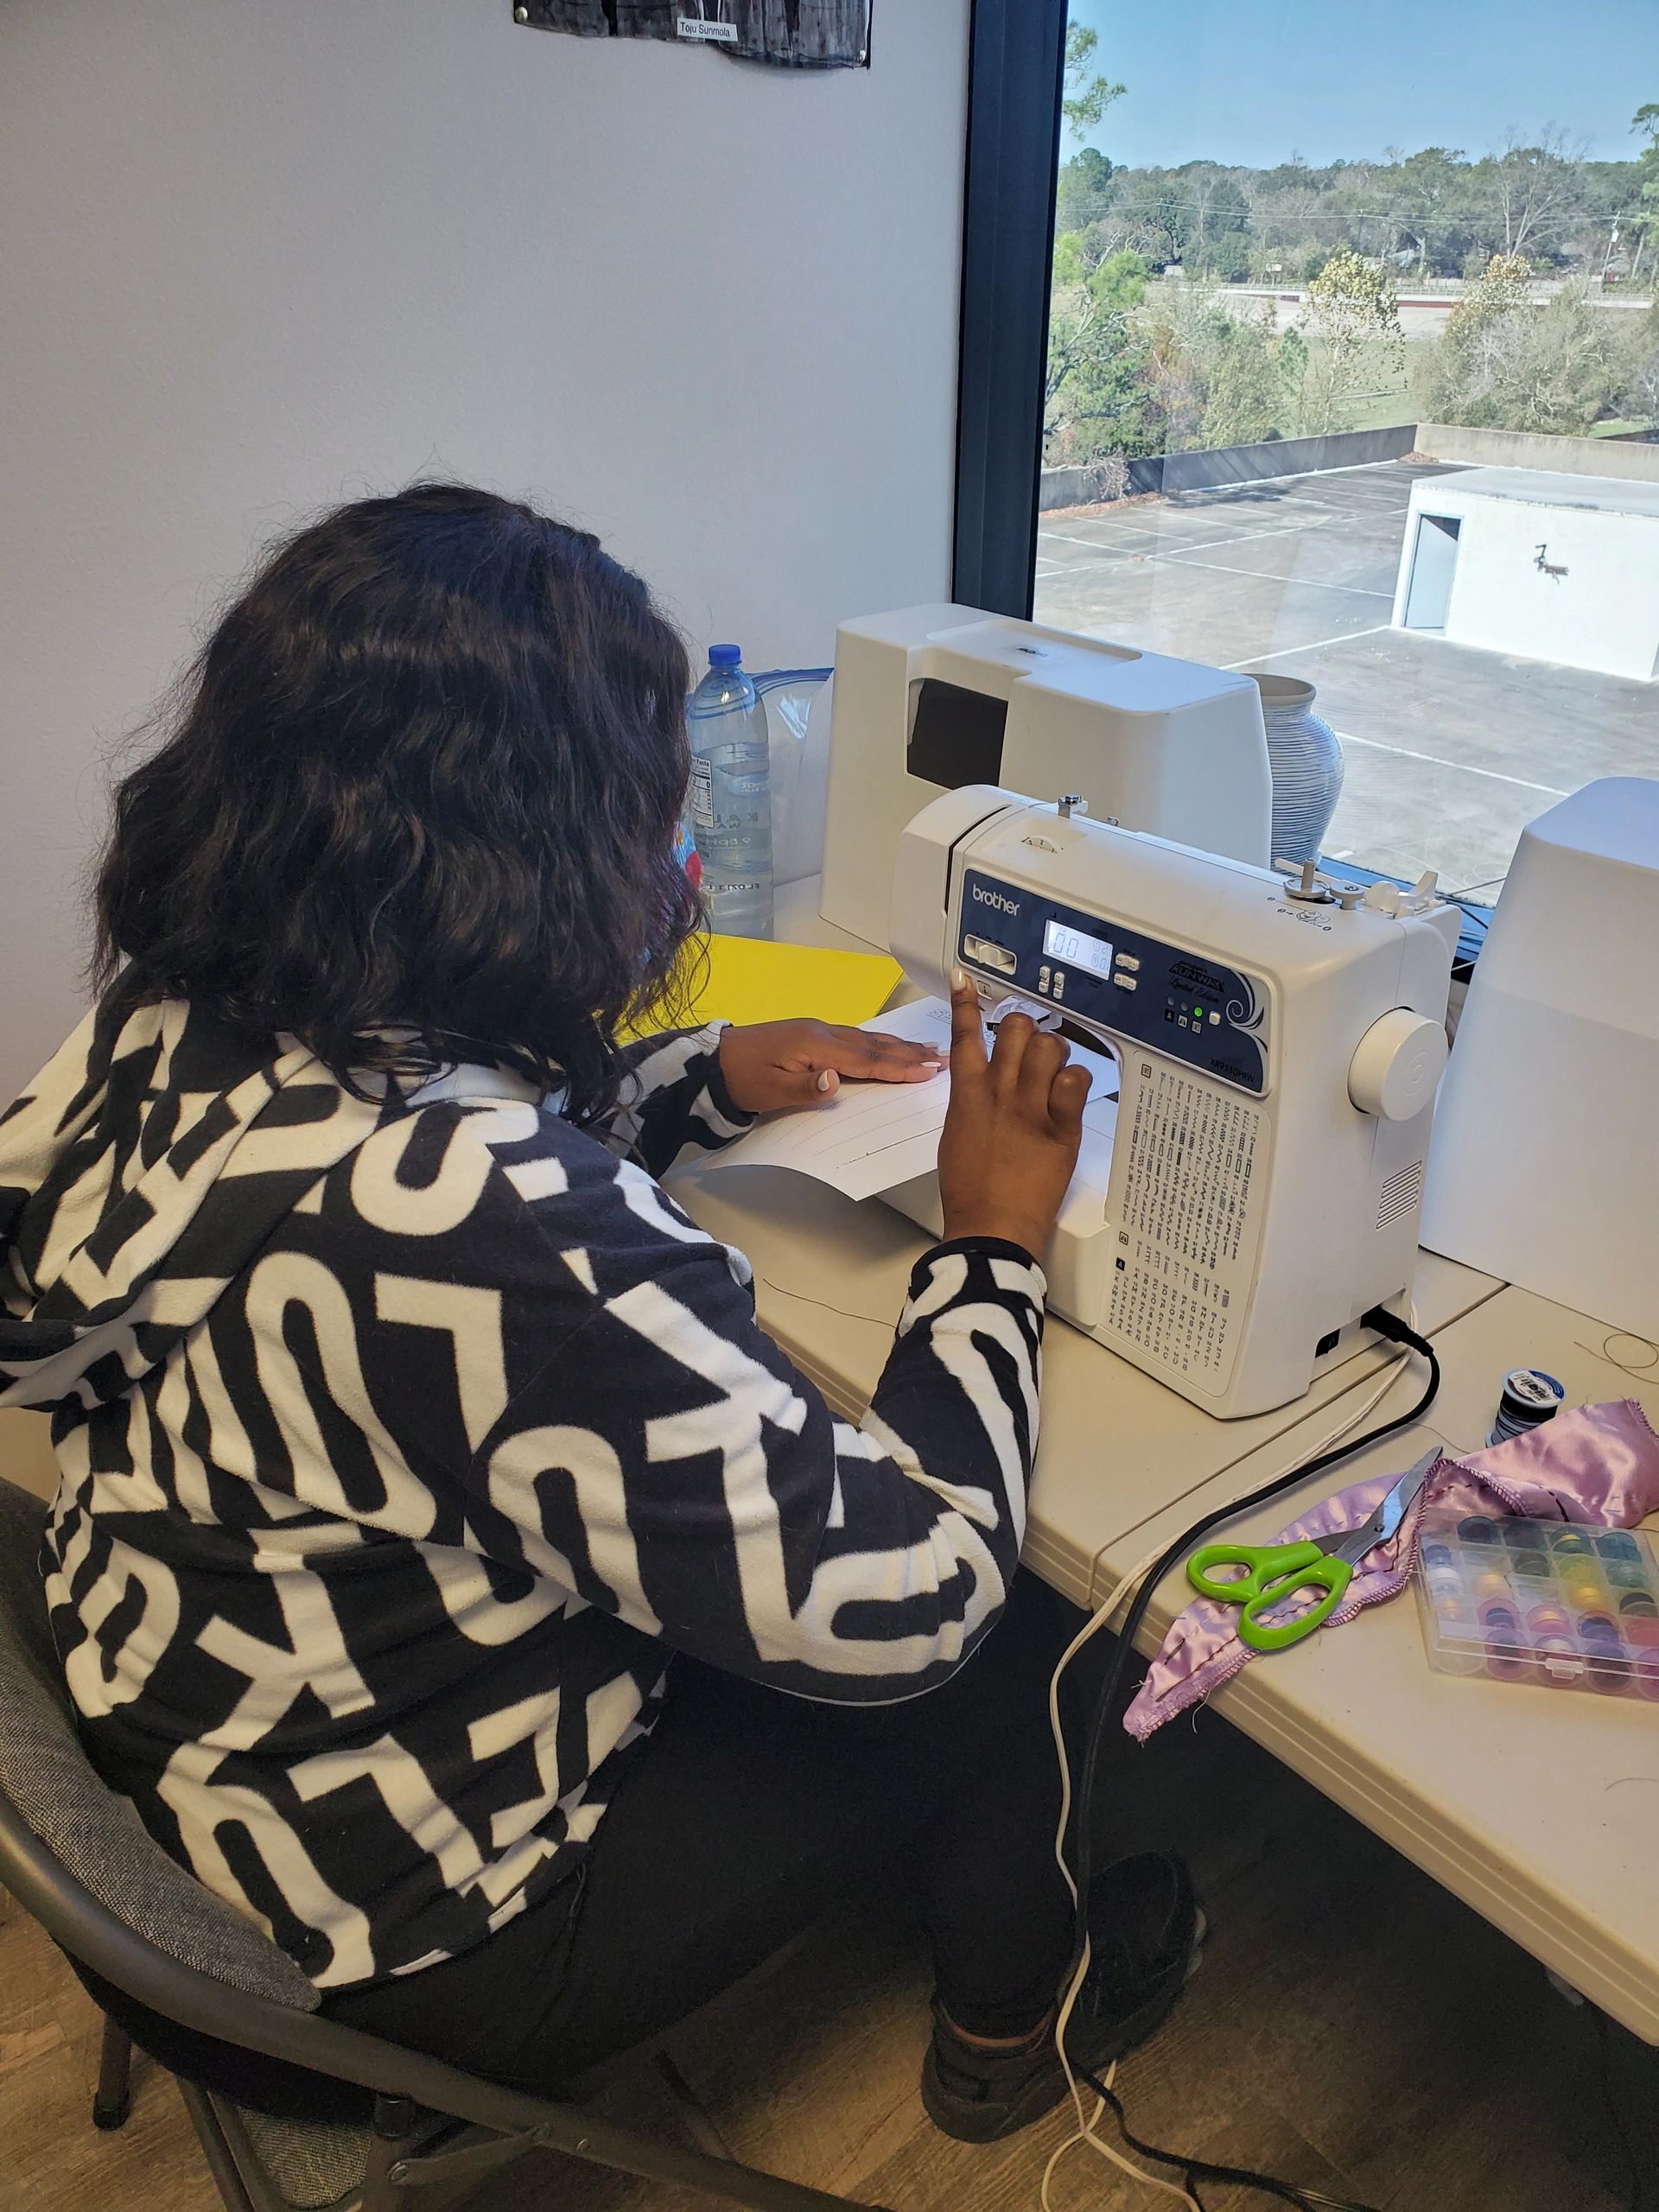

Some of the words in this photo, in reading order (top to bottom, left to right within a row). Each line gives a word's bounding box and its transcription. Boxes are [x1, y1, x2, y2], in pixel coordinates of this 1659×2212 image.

[681, 22, 696, 35] Toju
[698, 24, 730, 37] Sunmola
[972, 883, 1020, 917] brother
[1172, 965, 1222, 990] RUNWAY
